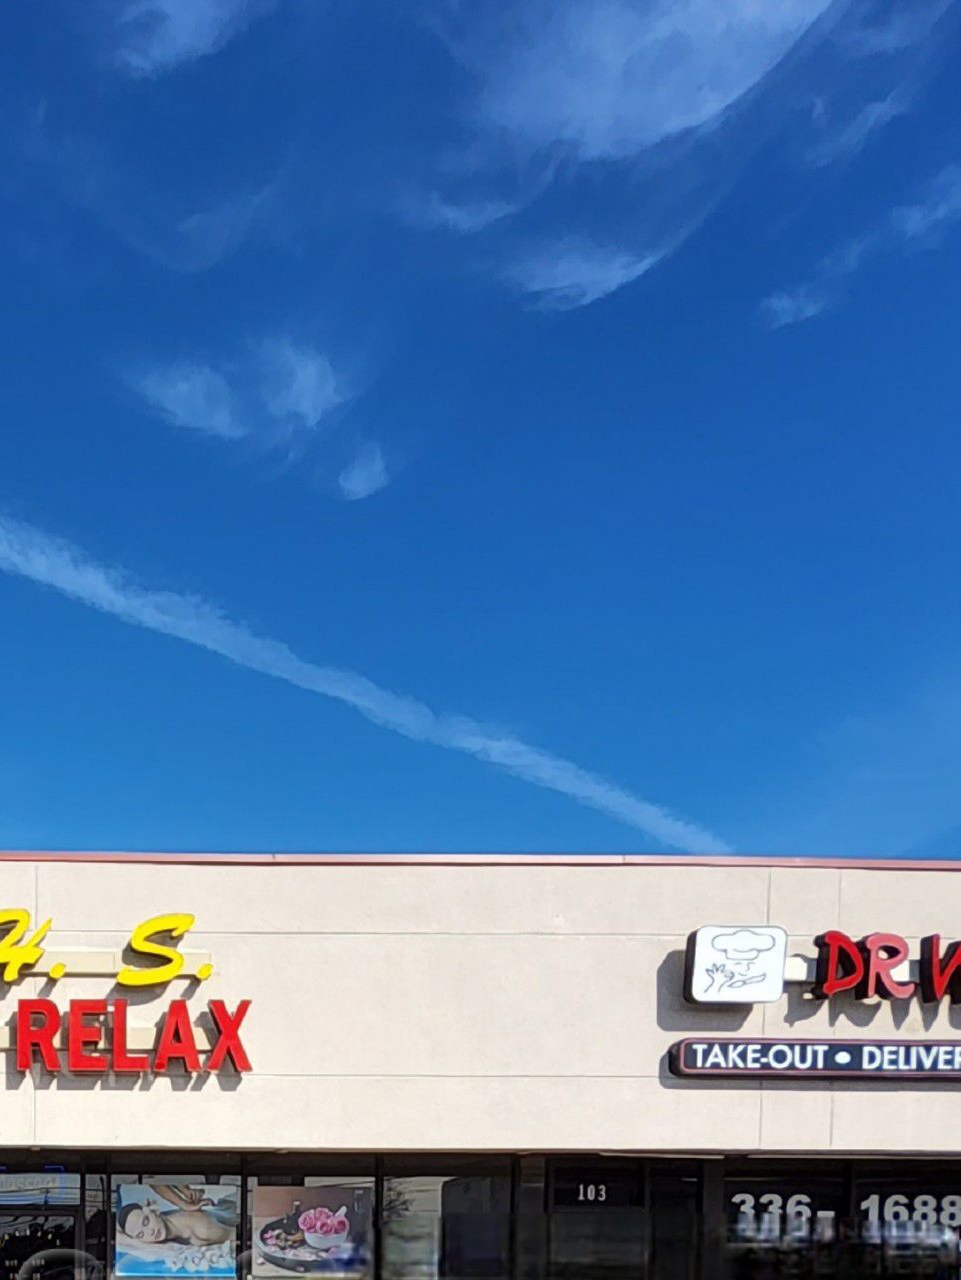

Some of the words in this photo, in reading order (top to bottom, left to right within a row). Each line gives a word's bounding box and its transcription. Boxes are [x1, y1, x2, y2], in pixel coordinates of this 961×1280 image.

[17, 998, 253, 1073] RELAX
[692, 1044, 829, 1070] TAKE-OUT
[578, 1183, 607, 1201] 103
